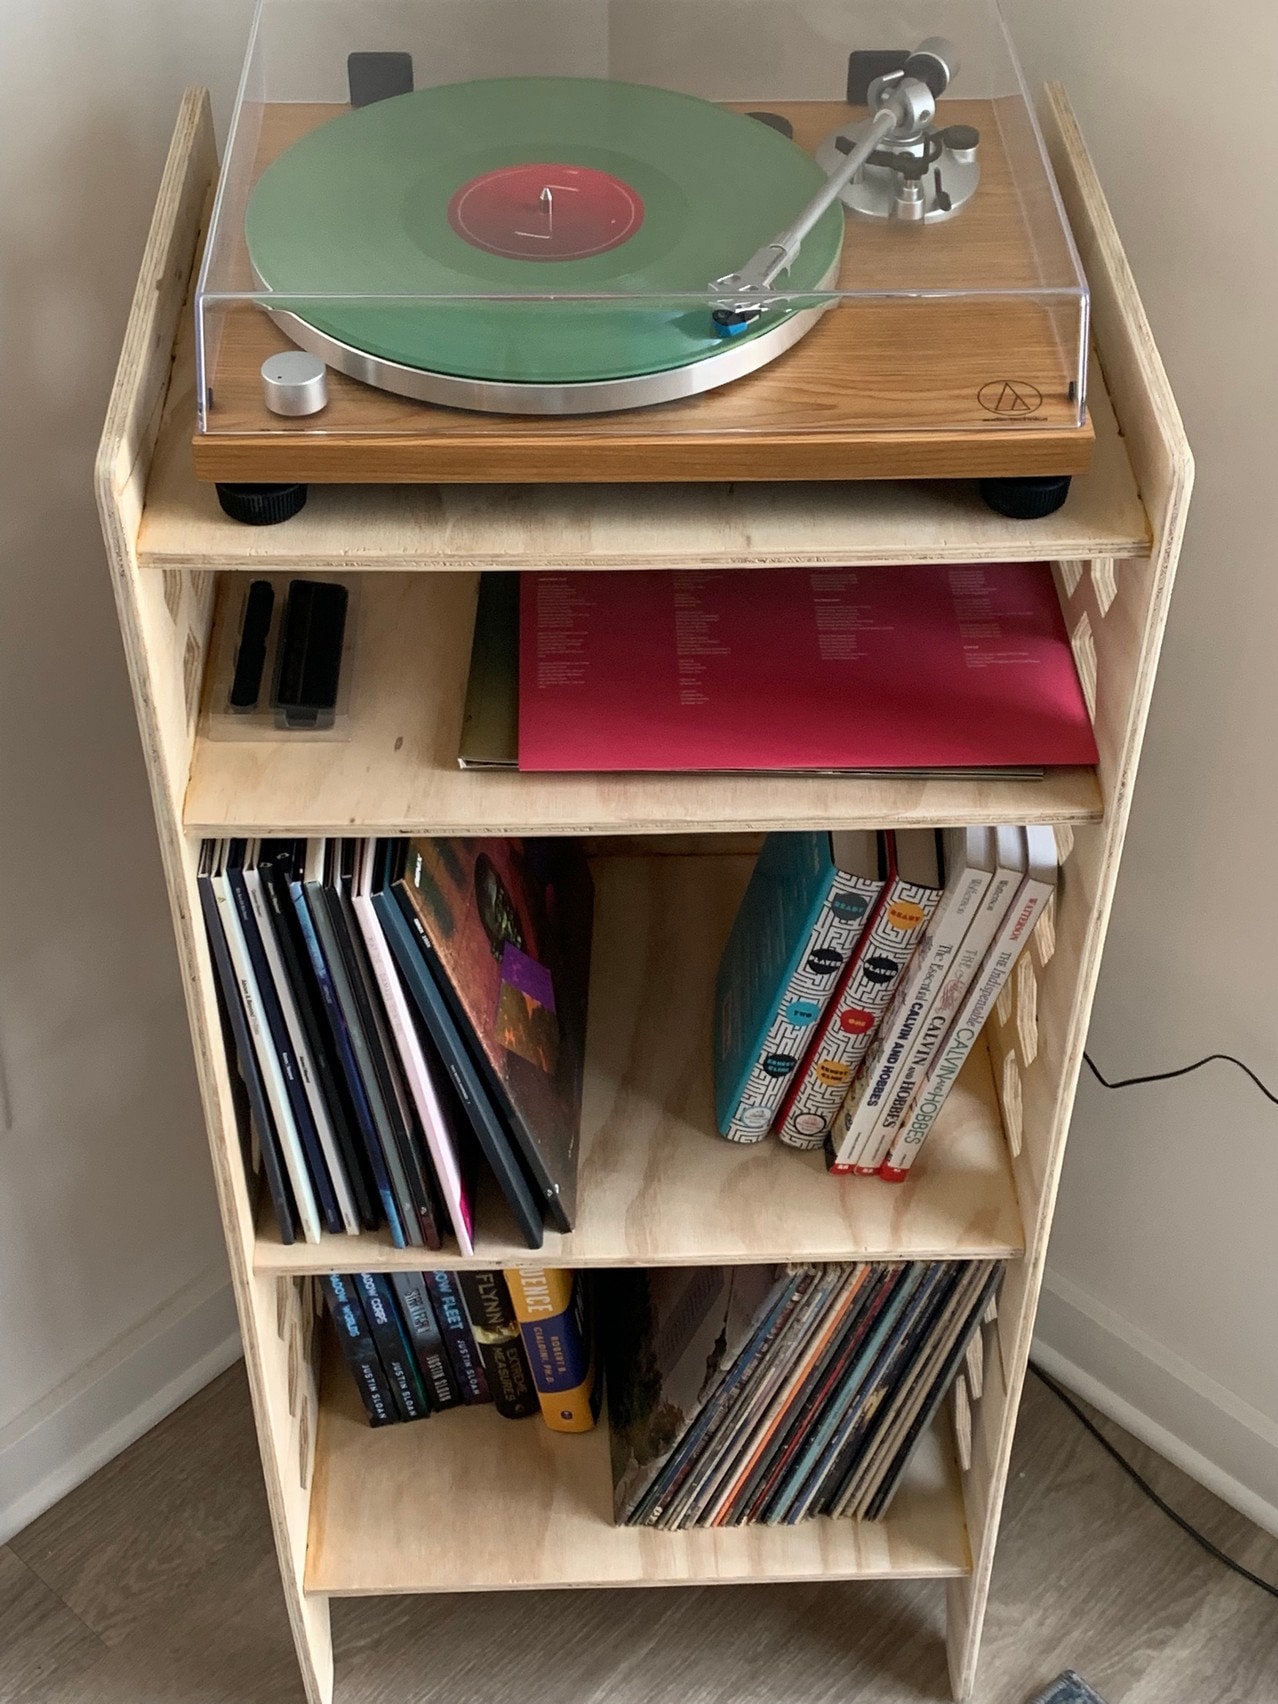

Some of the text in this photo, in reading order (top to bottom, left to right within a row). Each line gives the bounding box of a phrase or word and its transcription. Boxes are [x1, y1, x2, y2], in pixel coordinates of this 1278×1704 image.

[889, 908, 922, 923] READY
[1009, 897, 1038, 941] WATTERSON
[809, 954, 842, 967] PLAYER
[864, 962, 897, 976] PLAYER
[933, 944, 954, 963] The
[998, 951, 1012, 969] THE
[916, 960, 944, 1002] Essential
[966, 966, 1007, 1027] Indispensable
[899, 1001, 924, 1041] CALVIN
[913, 1015, 946, 1067] CALVIN
[887, 1041, 905, 1065] AND
[905, 1066, 915, 1080] AND
[936, 1027, 974, 1081] CALVIN
[867, 1064, 895, 1107] HOBBES
[882, 1080, 916, 1128] HOBBES
[934, 1079, 945, 1093] AND
[904, 1091, 942, 1145] HOBBES
[330, 1272, 360, 1337] ADOW WORLDS
[371, 1298, 388, 1325] CORPS
[434, 1271, 463, 1329] OW FLEET
[476, 1273, 505, 1324] FLYNN
[426, 1354, 445, 1380] JUSTIN
[457, 1340, 480, 1395] JUSTIN SLOAN
[507, 1347, 528, 1394] EXTREME
[551, 1336, 565, 1364] ROBERT
[362, 1364, 387, 1419] JUSTIN SLOAN
[392, 1362, 417, 1417] JUSTIN SLOAN
[493, 1346, 516, 1402] MEASURES
